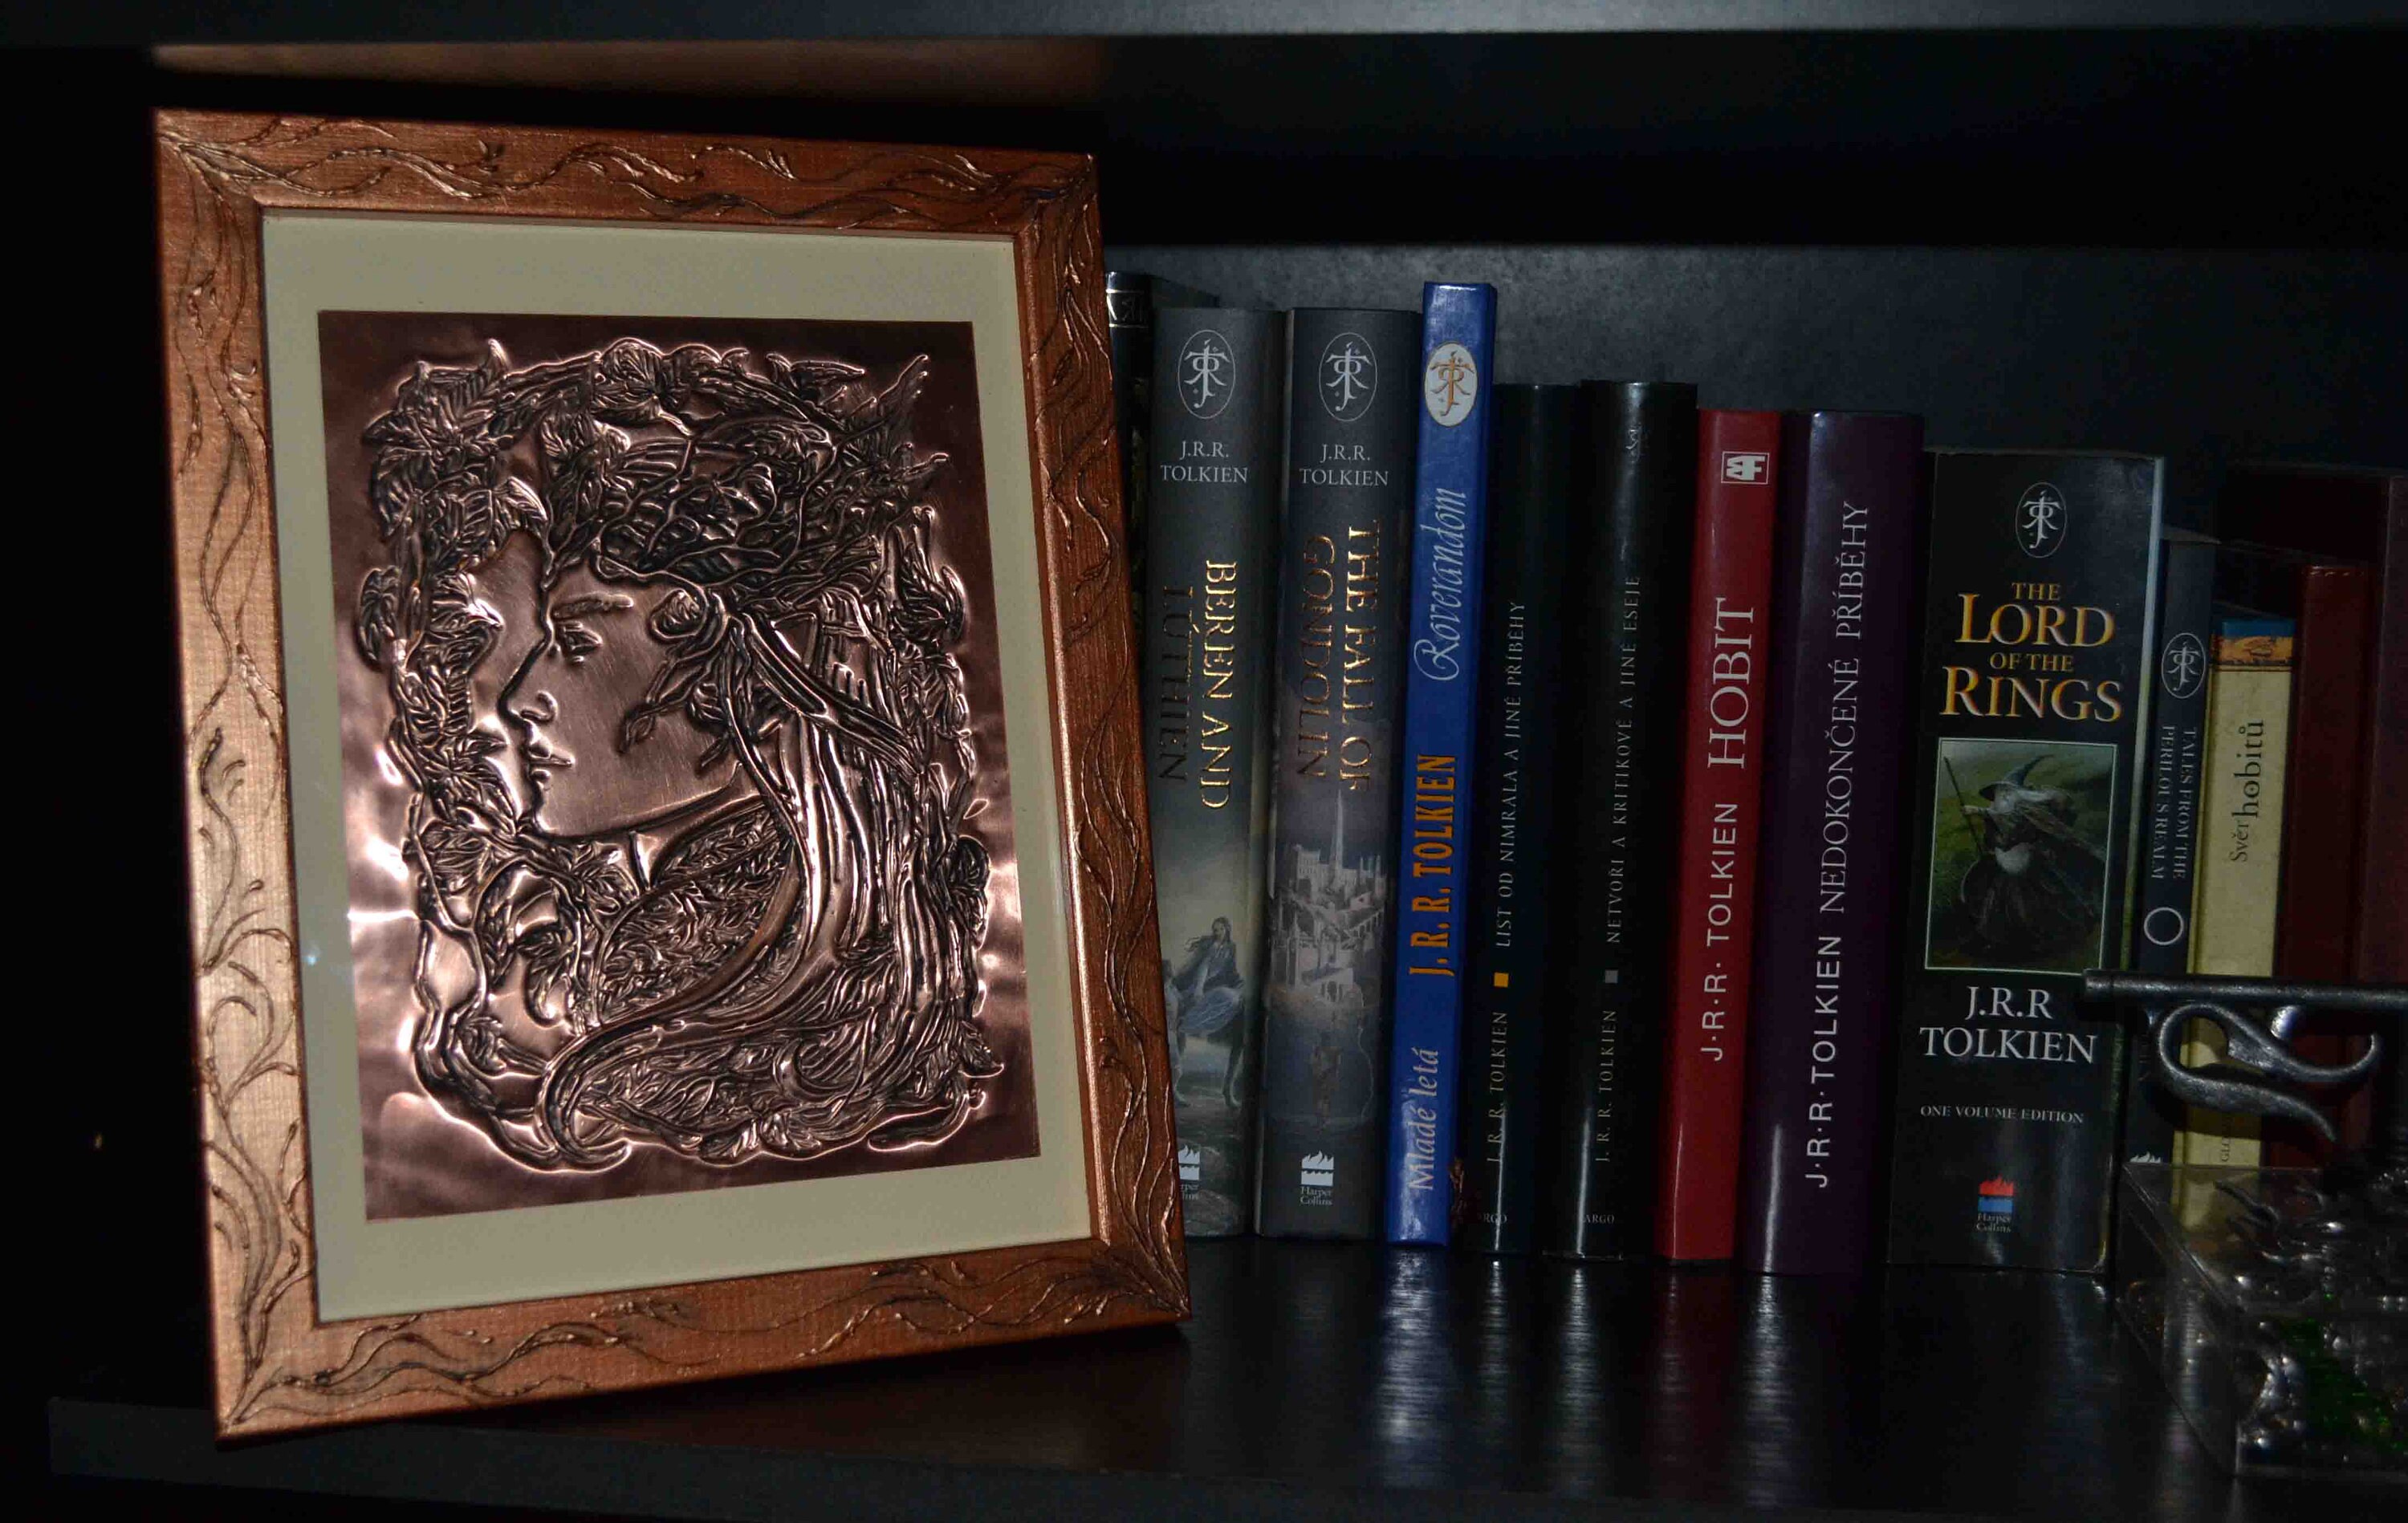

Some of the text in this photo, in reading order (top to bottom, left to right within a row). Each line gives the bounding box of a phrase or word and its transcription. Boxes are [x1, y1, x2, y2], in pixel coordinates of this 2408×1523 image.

[1161, 465, 1248, 483] TOLKIEN
[1179, 441, 1229, 461] J.R.R.
[1300, 469, 1389, 486] TOLKIEN
[1320, 445, 1371, 463] J.R.R.
[1413, 488, 1467, 682] Roverandom
[1832, 501, 1869, 641] PŘÍBĚHY
[2011, 582, 2061, 602] THE
[1623, 576, 1641, 632] ESEJE
[1954, 592, 2117, 648] LORD
[1158, 586, 1200, 781] LÚTHIEN
[1297, 535, 1335, 777] GONDOLIN
[1340, 520, 1381, 790] THE FALL OF
[1620, 644, 1637, 689] JINÉ
[1707, 597, 1755, 769] HOBIT
[1989, 652, 2075, 672] OF THE
[1201, 560, 1238, 809] BEREN AND
[1620, 697, 1633, 709] A
[1938, 664, 2125, 723] RINGS
[1503, 696, 1521, 738] JINÉ
[1503, 748, 1519, 762] A
[1612, 718, 1633, 825] KRITIKOVÉ
[1819, 658, 1860, 914] NEDOKONČENÉ
[2171, 726, 2198, 879] TALES FROM THE
[1413, 754, 1457, 878] TOLKIEN
[1500, 769, 1519, 863] NIMRALA
[1611, 835, 1626, 848] A
[1498, 871, 1515, 898] OD
[1706, 802, 1739, 948] TOLKIEN
[1495, 906, 1512, 948] LIST
[1811, 936, 1843, 1085] TOLKIEN
[1965, 985, 2054, 1021] J.R.R
[1489, 1011, 1508, 1094] TOLKIEN
[1598, 1010, 1617, 1094] TOLKIEN
[1919, 1026, 2099, 1064] TOLKIEN
[1406, 1046, 1439, 1191] Mladé letá
[1920, 1105, 2084, 1124] ONE VOLUME EDITION
